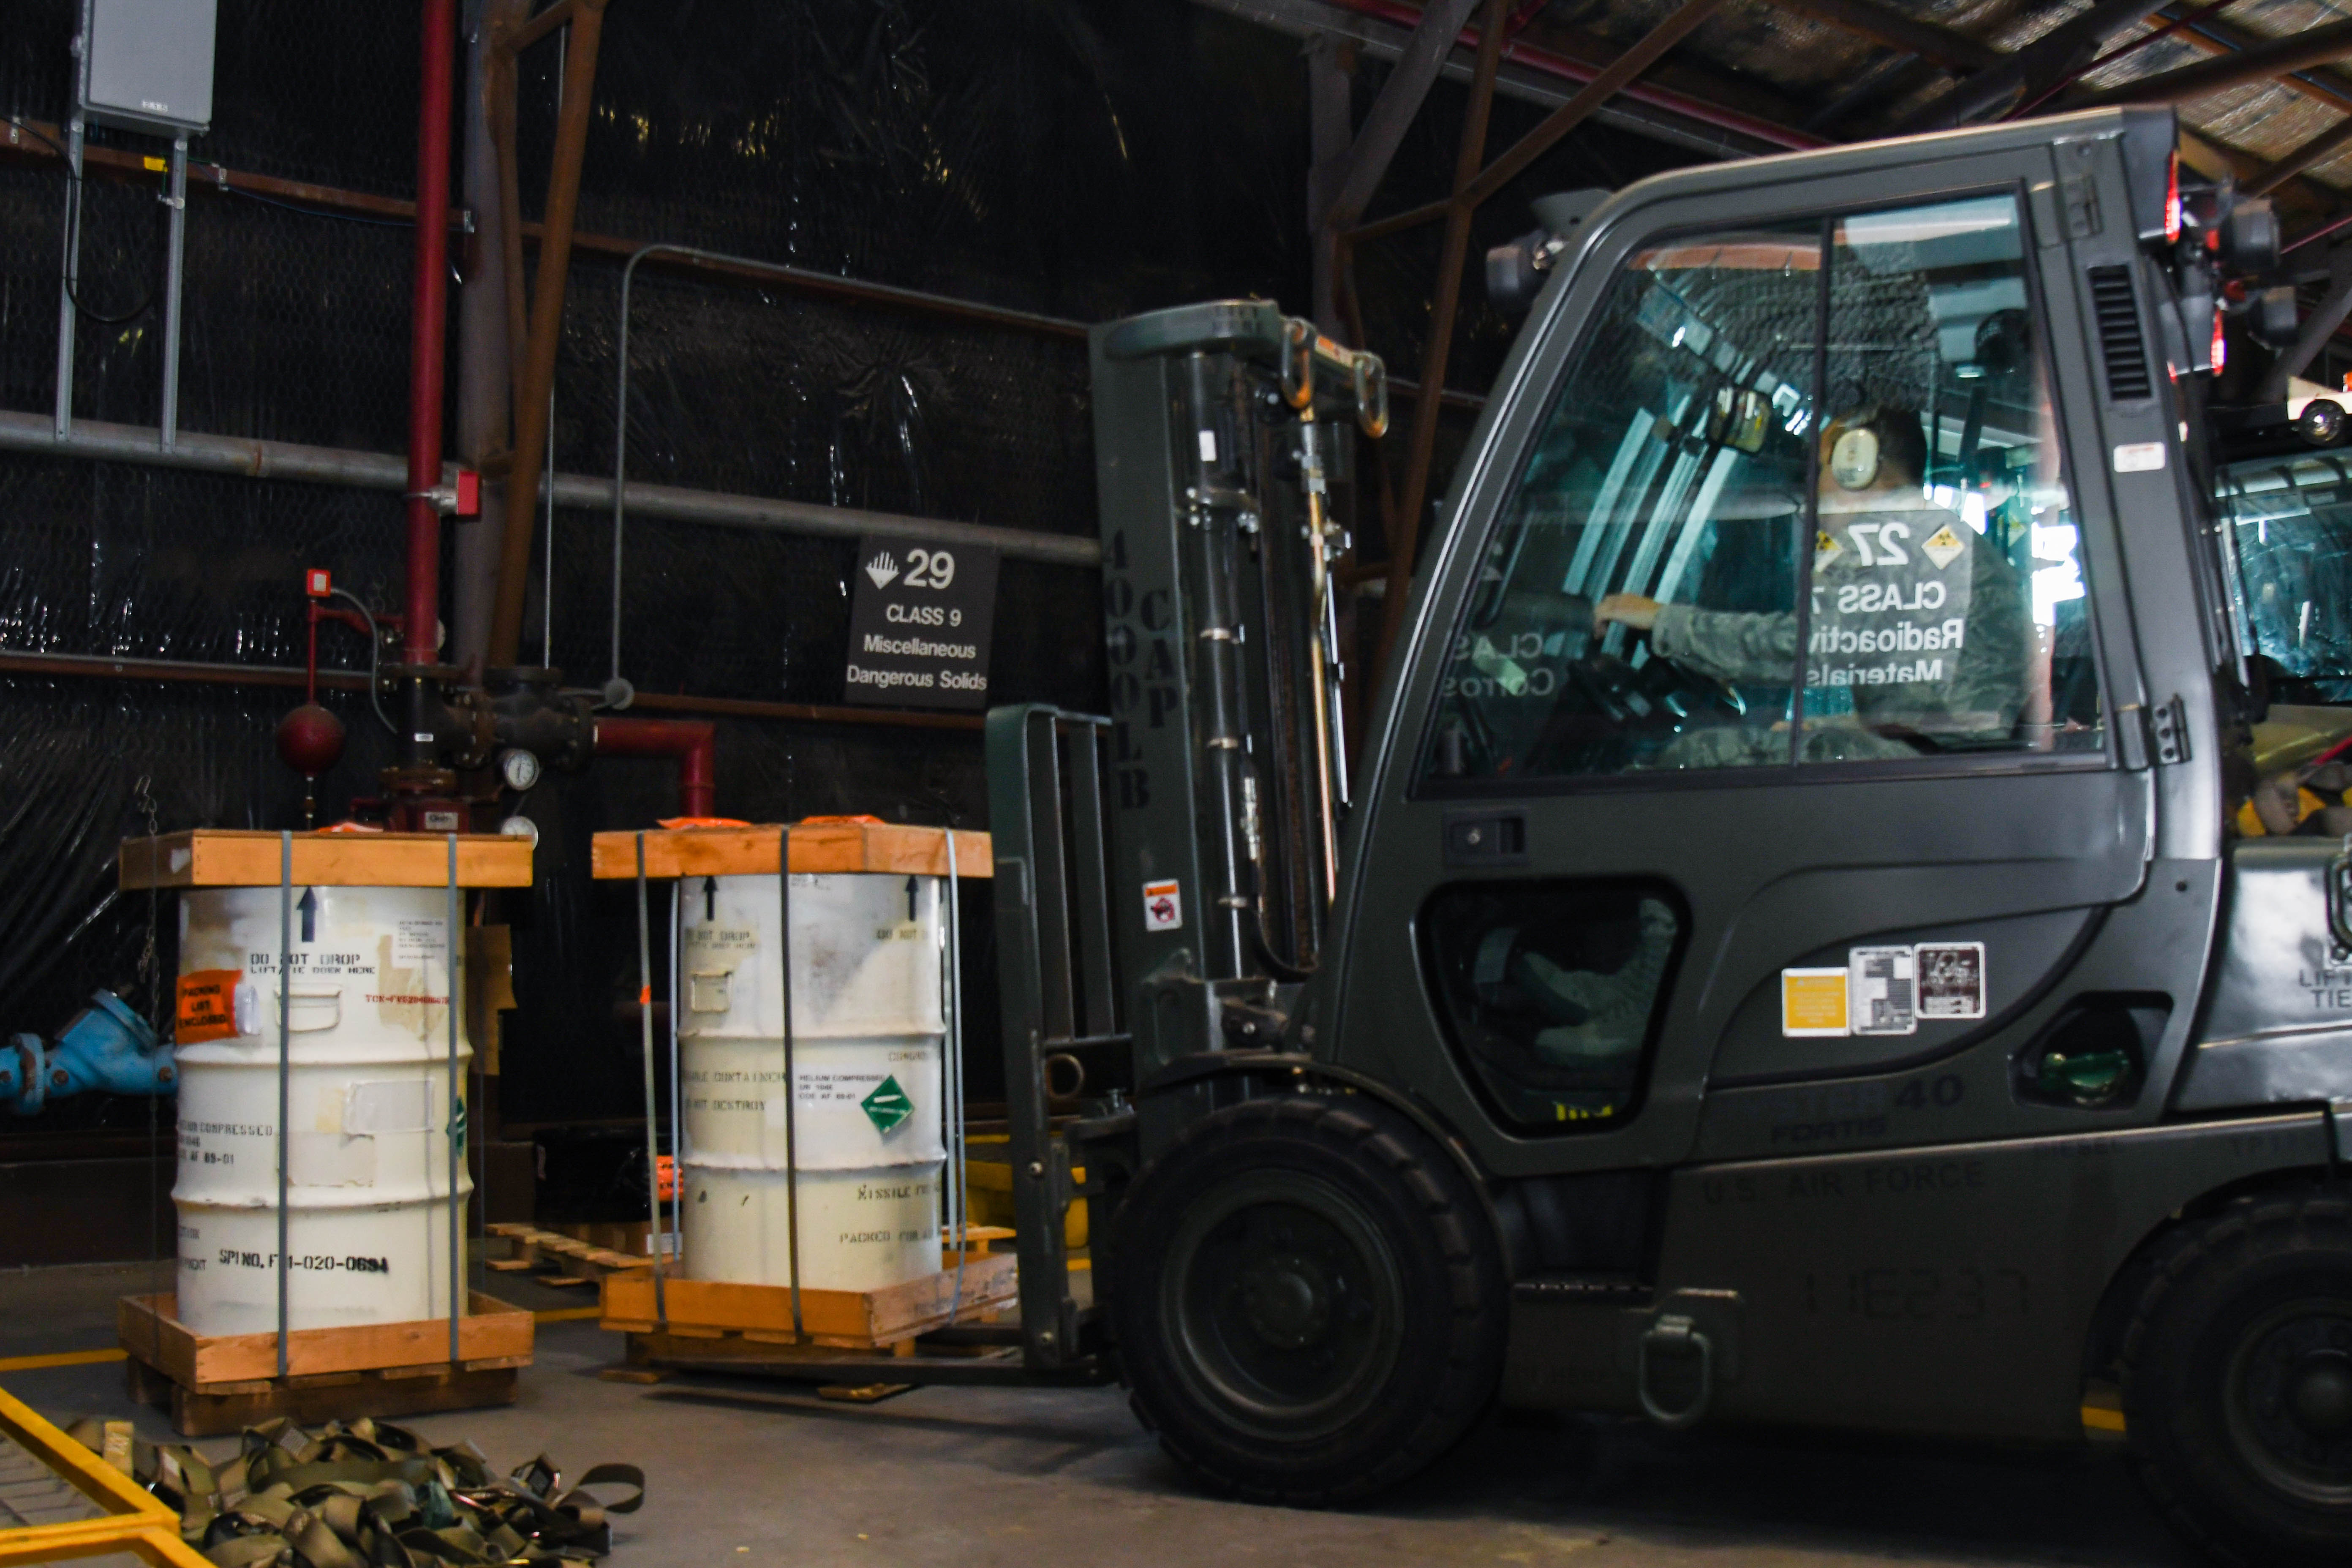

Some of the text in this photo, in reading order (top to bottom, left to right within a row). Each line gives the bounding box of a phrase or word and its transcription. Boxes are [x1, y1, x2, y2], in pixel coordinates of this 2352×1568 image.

[904, 549, 955, 589] 29
[887, 604, 962, 627] CLASS 9
[864, 635, 976, 659] Miscellaneous
[847, 665, 987, 691] Dangerous Solids
[250, 953, 269, 965] DO
[320, 953, 360, 965] DROP
[191, 1000, 211, 1012] LIST
[2311, 989, 2351, 1008] TIE
[1896, 1074, 1963, 1109] 40
[200, 1122, 272, 1136] COMPRESSED
[1787, 1171, 1844, 1197] AIR
[1866, 1161, 1984, 1194] FORCE
[858, 1185, 911, 1200] MISSILE
